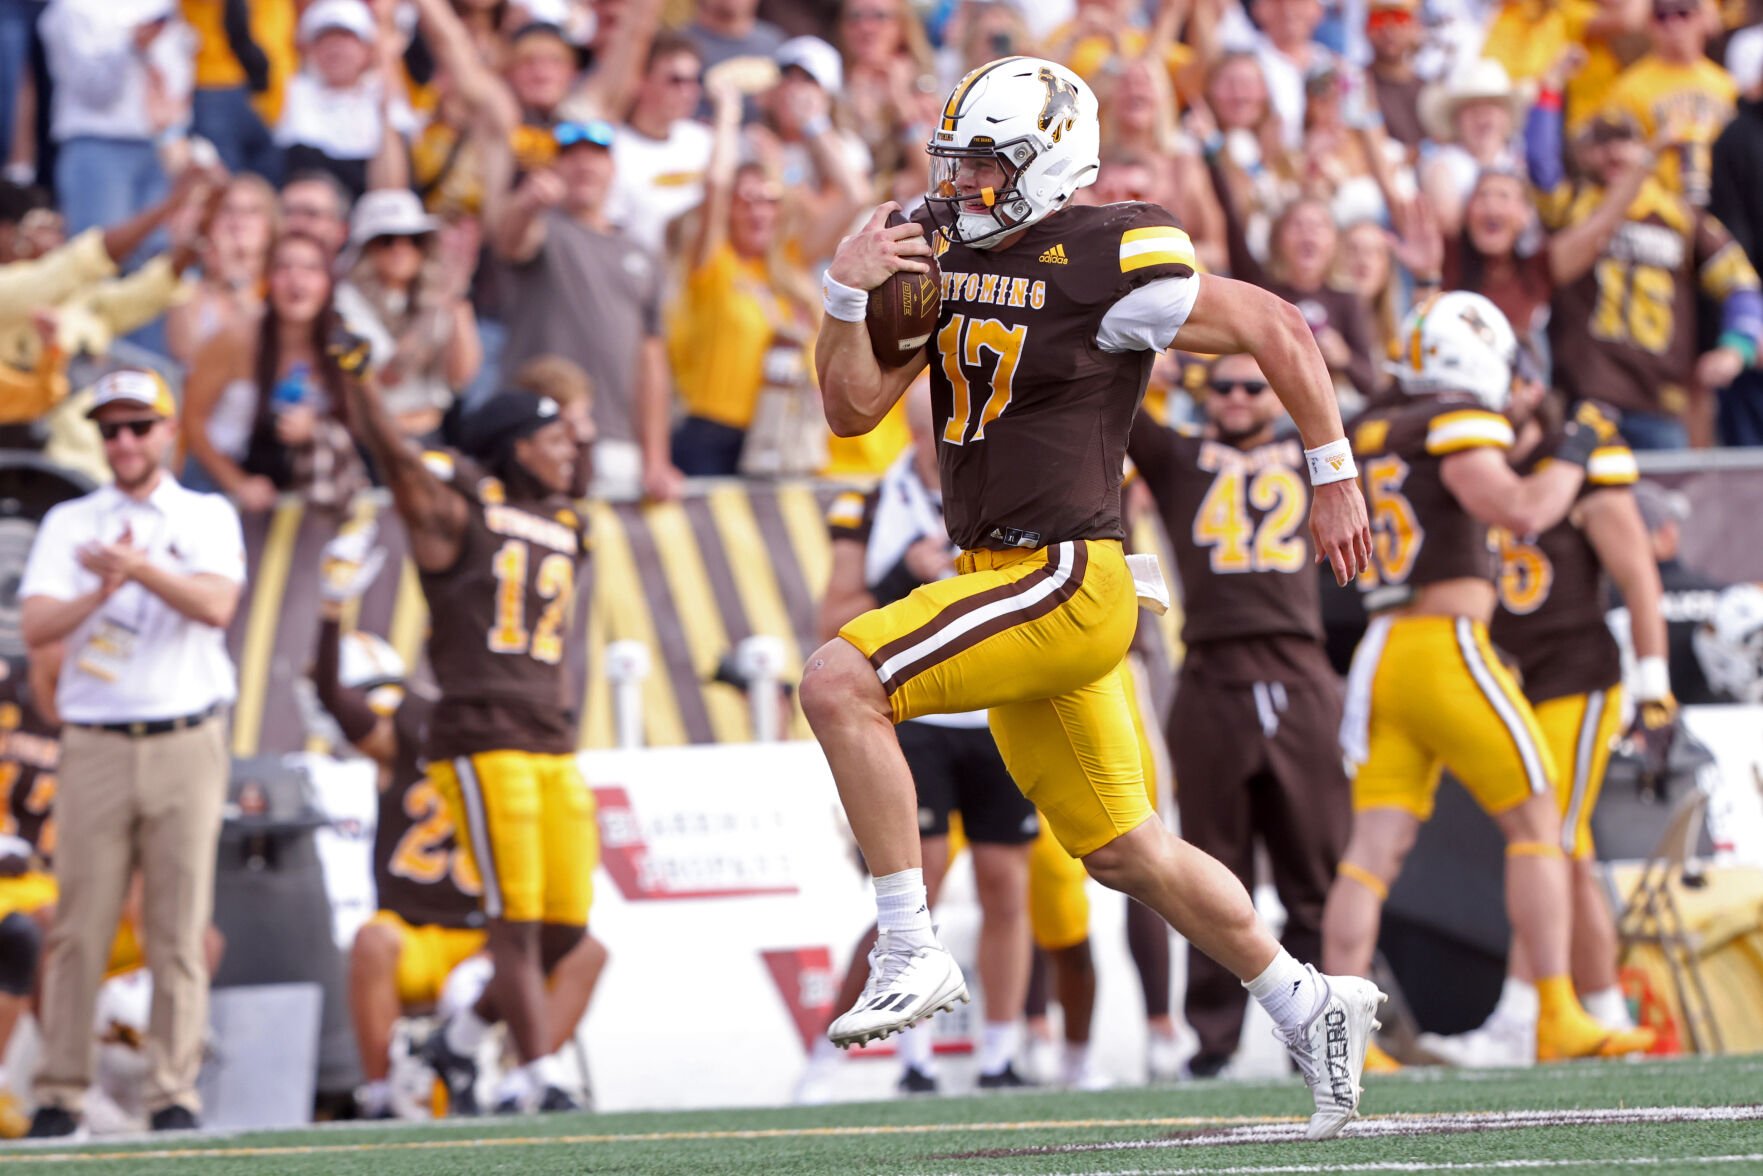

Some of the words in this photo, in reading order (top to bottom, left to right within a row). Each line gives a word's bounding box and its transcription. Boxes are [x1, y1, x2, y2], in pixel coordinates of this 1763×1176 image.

[941, 271, 1046, 310] WYOMING
[1038, 254, 1069, 265] adidas
[937, 313, 1028, 446] 17
[1192, 464, 1308, 574] 42
[487, 538, 575, 666] 12
